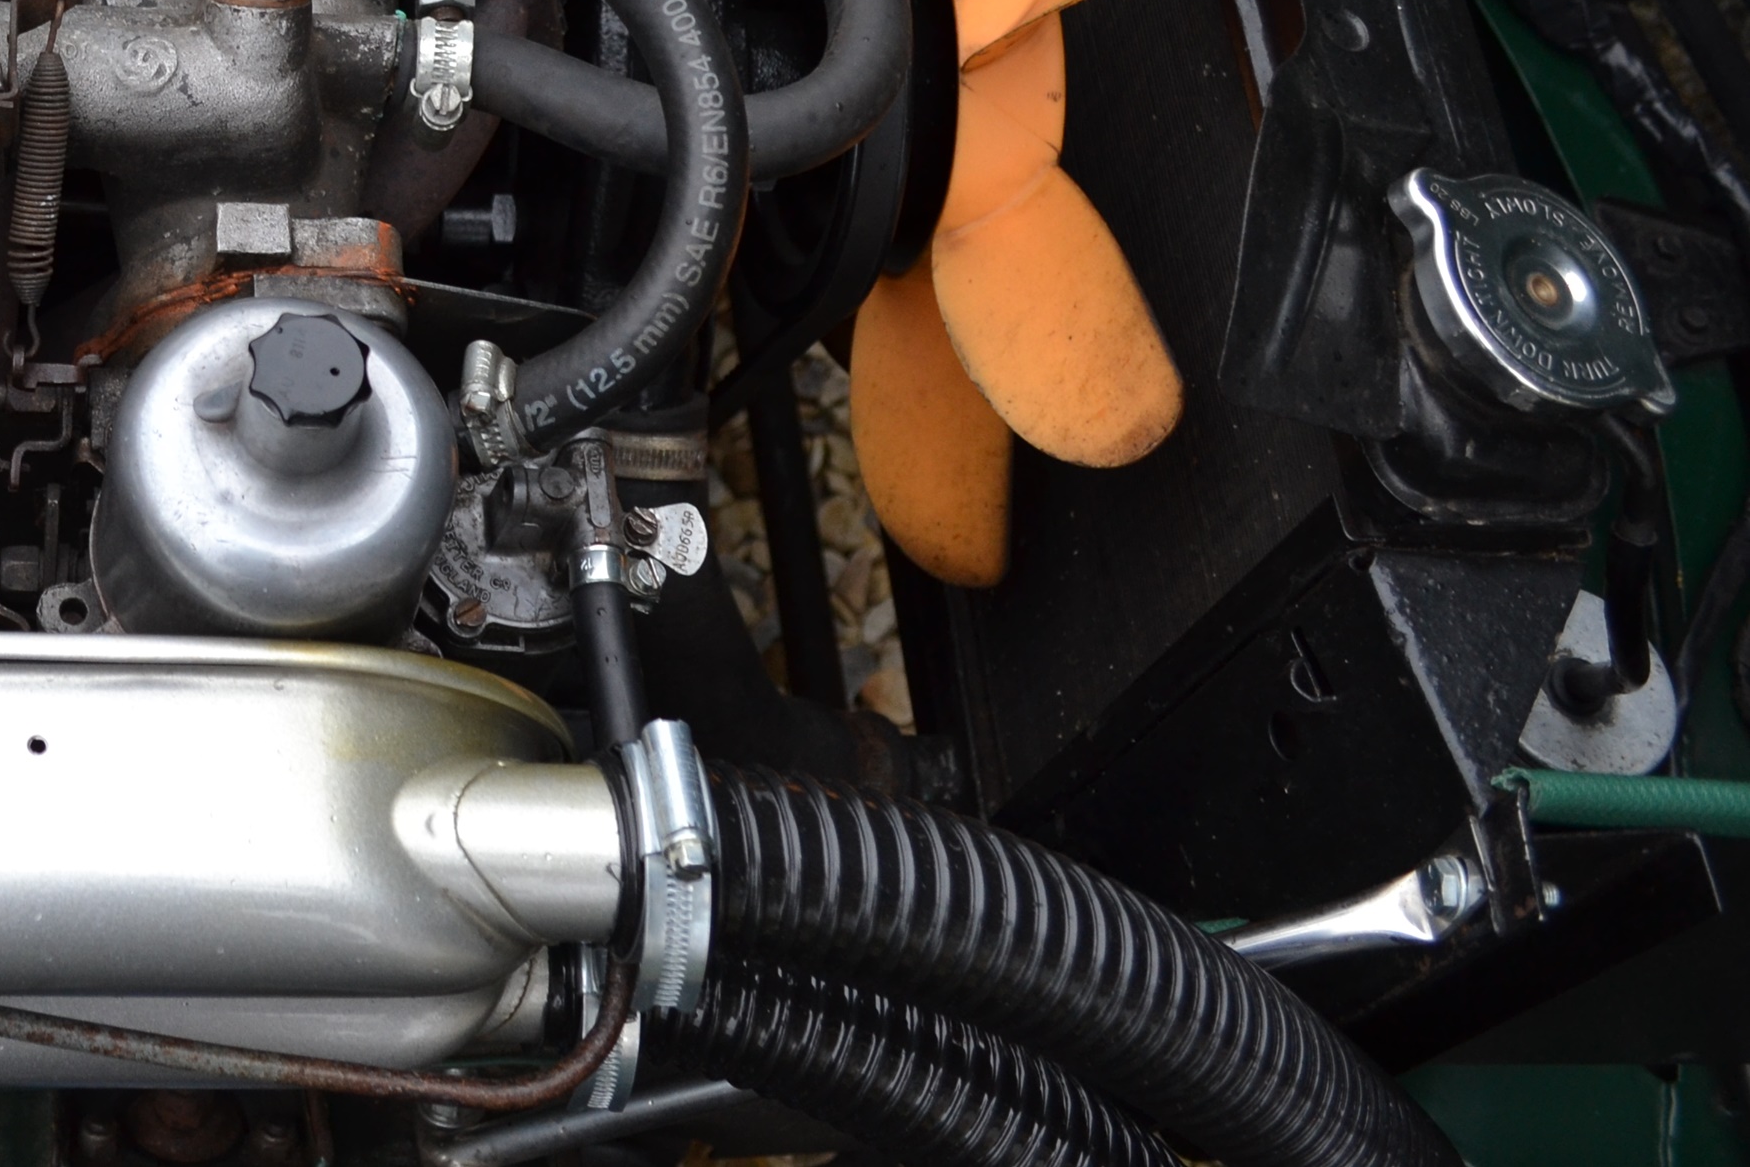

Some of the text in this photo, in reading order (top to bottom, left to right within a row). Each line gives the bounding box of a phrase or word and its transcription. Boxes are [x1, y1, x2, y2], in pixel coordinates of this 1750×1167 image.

[686, 53, 730, 210] R6/EN854
[1430, 181, 1481, 228] LBS 20
[674, 217, 720, 287] SAE
[1483, 195, 1636, 335] REMOVE SLOWLY
[633, 291, 690, 354] mm)
[1460, 235, 1621, 382] TURN DOWN TIGHT
[566, 347, 637, 411] (12.5
